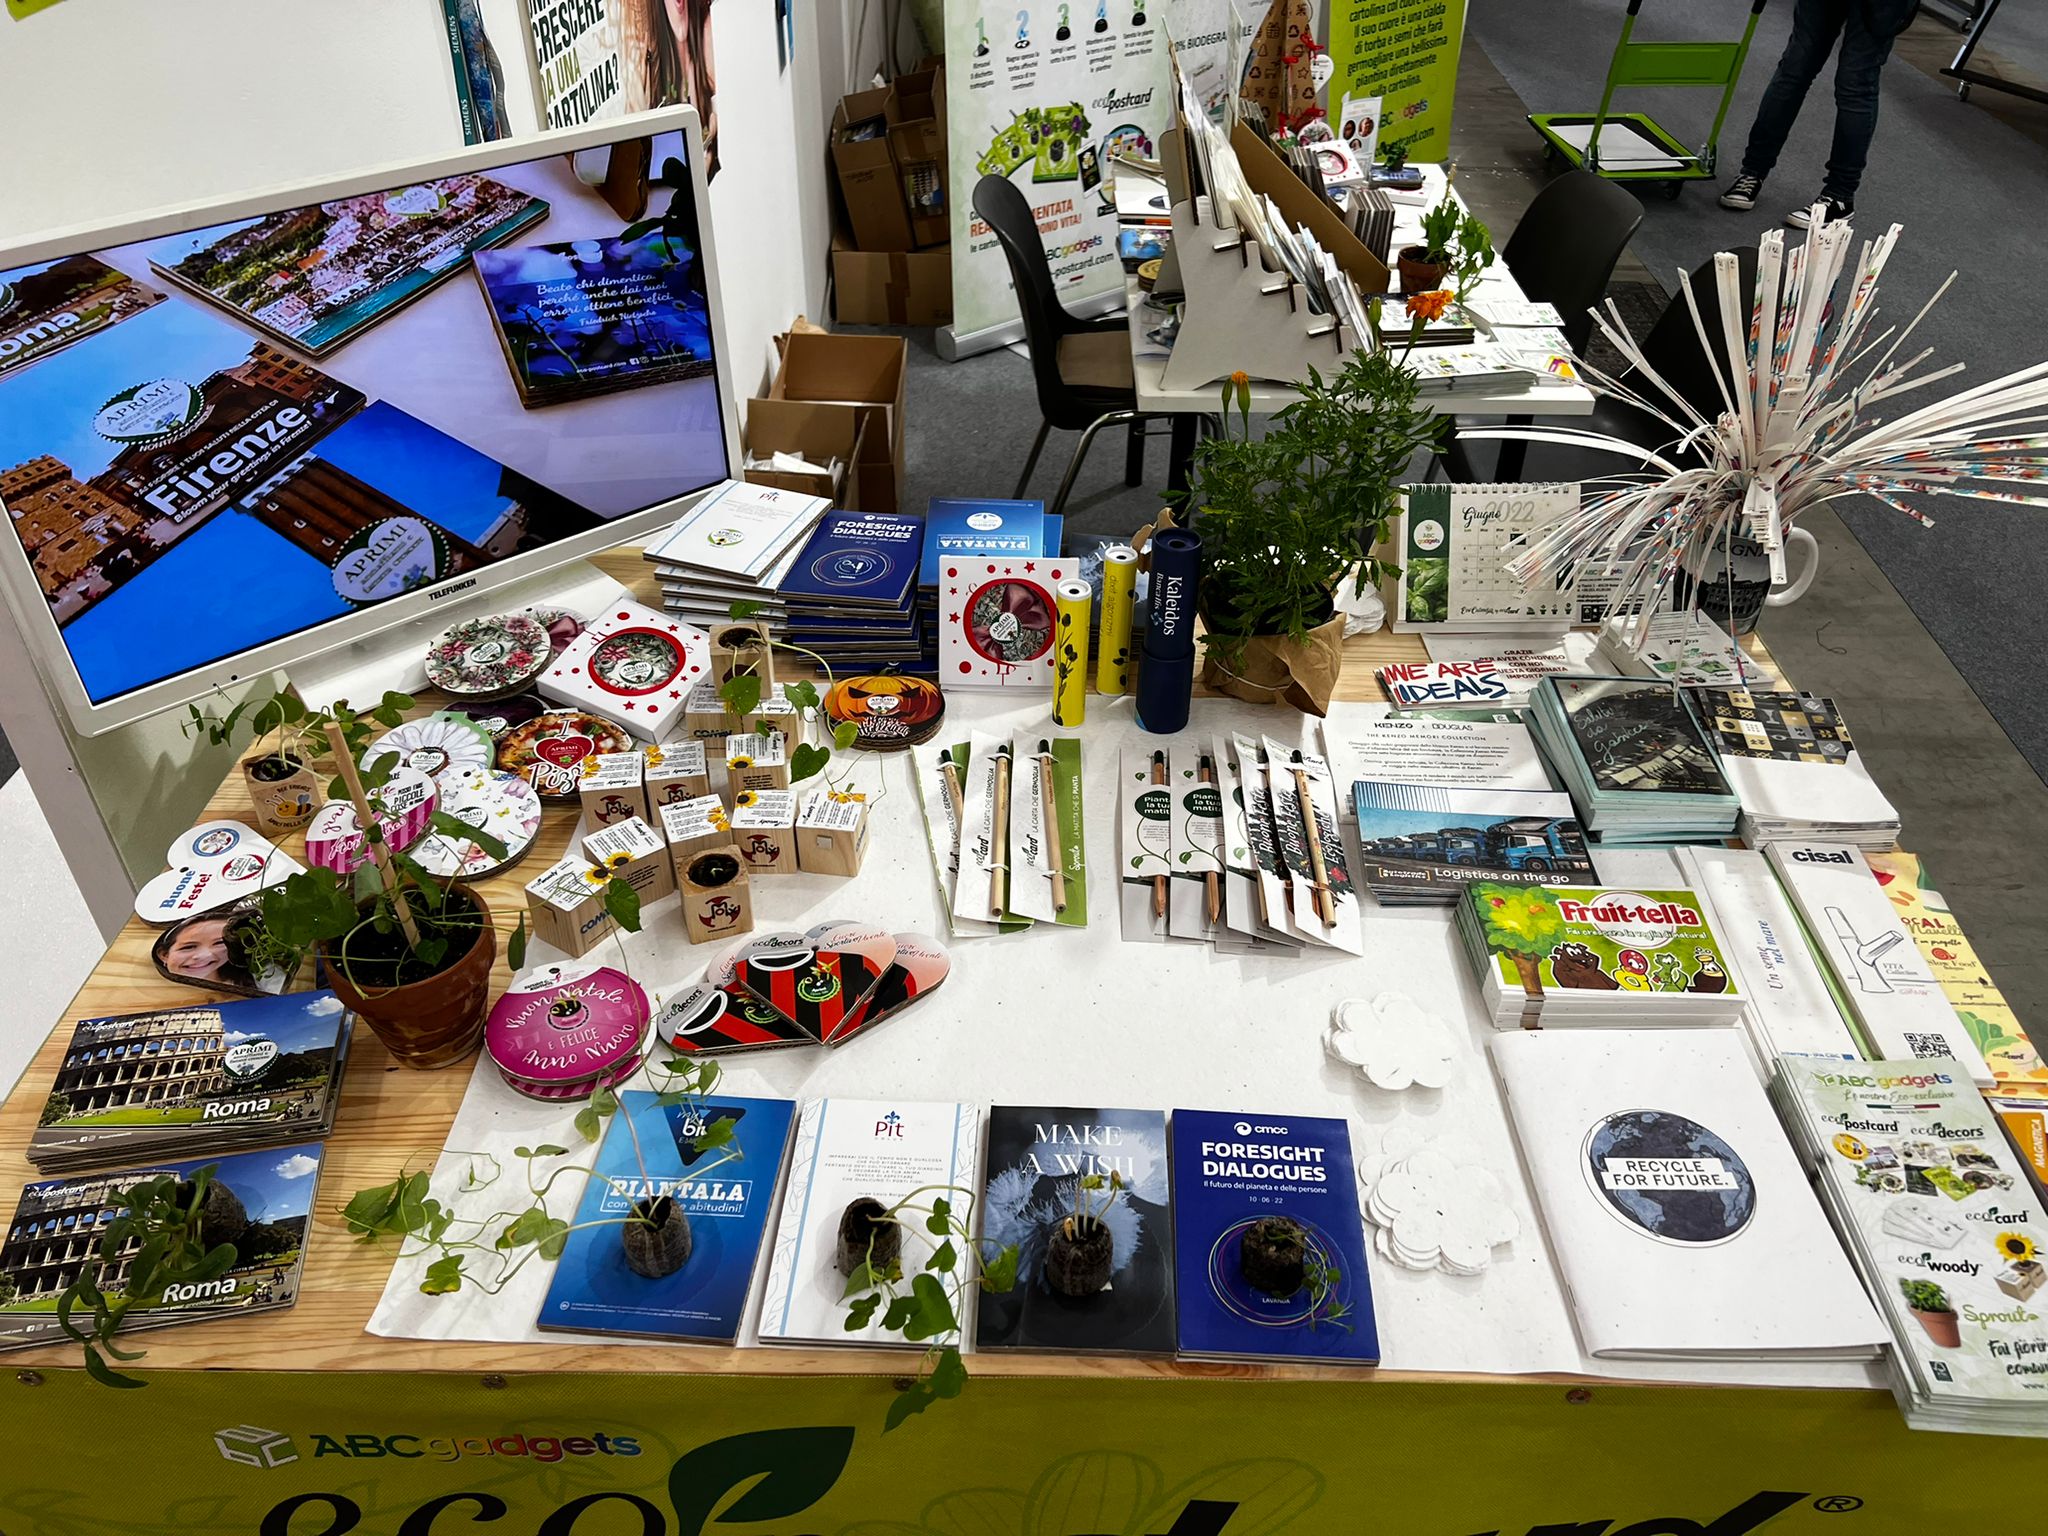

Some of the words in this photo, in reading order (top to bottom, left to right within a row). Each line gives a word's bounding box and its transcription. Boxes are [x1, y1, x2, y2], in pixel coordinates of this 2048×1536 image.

[1361, 25, 1377, 36] suo
[1378, 19, 1399, 32] cuore
[1407, 10, 1422, 24] una
[1423, 4, 1446, 19] cialda
[448, 15, 461, 54] SIEMENS
[554, 47, 582, 94] UNA
[1389, 53, 1437, 77] direttamente
[461, 98, 473, 136] SIEMENS
[1060, 214, 1082, 230] VITA!
[537, 282, 574, 296] Beato
[575, 277, 597, 291] chi
[538, 292, 581, 310] perché
[581, 289, 618, 301] anche
[620, 284, 642, 296] dai
[542, 304, 581, 319] errori
[582, 300, 625, 313] ottiene
[578, 315, 619, 328] Friedrich
[106, 384, 171, 425] APRIMI
[144, 407, 308, 516] Firenze
[174, 494, 209, 524] Bloom
[208, 480, 230, 501] your
[229, 452, 272, 484] greetings
[280, 420, 313, 447] Firenze!
[1462, 506, 1501, 528] Giugno
[1484, 501, 1535, 522] 2022
[832, 528, 912, 539] DIALOGUES
[837, 521, 917, 532] FORESIGHT
[344, 523, 409, 584] APRIMI
[940, 540, 1027, 549] PIANTALA
[428, 577, 477, 601] TELEFUNKEN
[1162, 576, 1183, 636] Kaleidos
[992, 614, 1011, 634] APRIMI
[623, 663, 648, 672] APRIMI
[1518, 654, 1566, 662] CONDIVISO
[1385, 663, 1428, 684] WE
[1438, 660, 1497, 678] ARE
[1400, 672, 1508, 703] IDEALS
[1431, 723, 1474, 731] DOUGLAS
[1573, 706, 1615, 730] Saluti
[938, 778, 951, 809] GERMOGLIA
[986, 767, 995, 799] GERMOGLIA
[394, 787, 425, 804] PICCOLE
[1250, 787, 1269, 818] Feste
[1279, 788, 1298, 818] Feste
[1072, 814, 1081, 833] MATITA
[1258, 820, 1275, 854] Buone
[1286, 820, 1304, 856] Buone
[1791, 848, 1855, 865] cisal
[1434, 868, 1499, 880] Logistics
[1501, 873, 1521, 882] on
[1523, 872, 1548, 882] the
[1550, 875, 1570, 884] go
[159, 869, 197, 910] Buone
[178, 872, 213, 910] Feste!
[1559, 901, 1700, 926] Fruit-tella
[1901, 917, 1945, 929] OCAL
[752, 937, 805, 948] ecodecors
[1566, 927, 1582, 935] Fai
[1582, 929, 1625, 938] crescere
[1758, 920, 1777, 946] mare
[1931, 939, 1962, 947] progetto
[1757, 945, 1776, 971] seme
[1765, 947, 1785, 965] nel
[1767, 973, 1784, 990] Un
[505, 995, 553, 1030] Buon
[558, 982, 625, 1004] Natale
[662, 986, 703, 1025] ecodecors
[522, 1049, 578, 1070] Anno
[585, 1024, 636, 1060] Nuovo
[547, 1042, 555, 1050] E
[559, 1027, 600, 1049] FELICE
[232, 1045, 272, 1056] APRIMI
[1859, 1091, 1888, 1100] nostre
[1889, 1091, 1956, 1103] Eco-esclusive
[203, 1098, 271, 1119] Roma
[874, 1121, 905, 1137] Pit
[1034, 1123, 1122, 1146] MAKE
[1254, 1125, 1288, 1135] cmcc
[1201, 1142, 1325, 1163] FORESIGHT
[1022, 1153, 1042, 1174] A
[1202, 1161, 1327, 1182] DIALOGUES
[1625, 1160, 1705, 1172] RECYCLE
[609, 1179, 746, 1202] PIANTALA
[1209, 1181, 1233, 1189] futuro
[1246, 1183, 1273, 1192] pianeta
[1298, 1186, 1328, 1194] persone
[1613, 1174, 1649, 1186] FOR
[1652, 1174, 1729, 1186] FUTURE.
[607, 1200, 628, 1209] con
[689, 1203, 742, 1214] abitudini!
[162, 1278, 237, 1304] Roma
[185, 1299, 215, 1308] greetings
[1988, 1339, 2011, 1358] Fai
